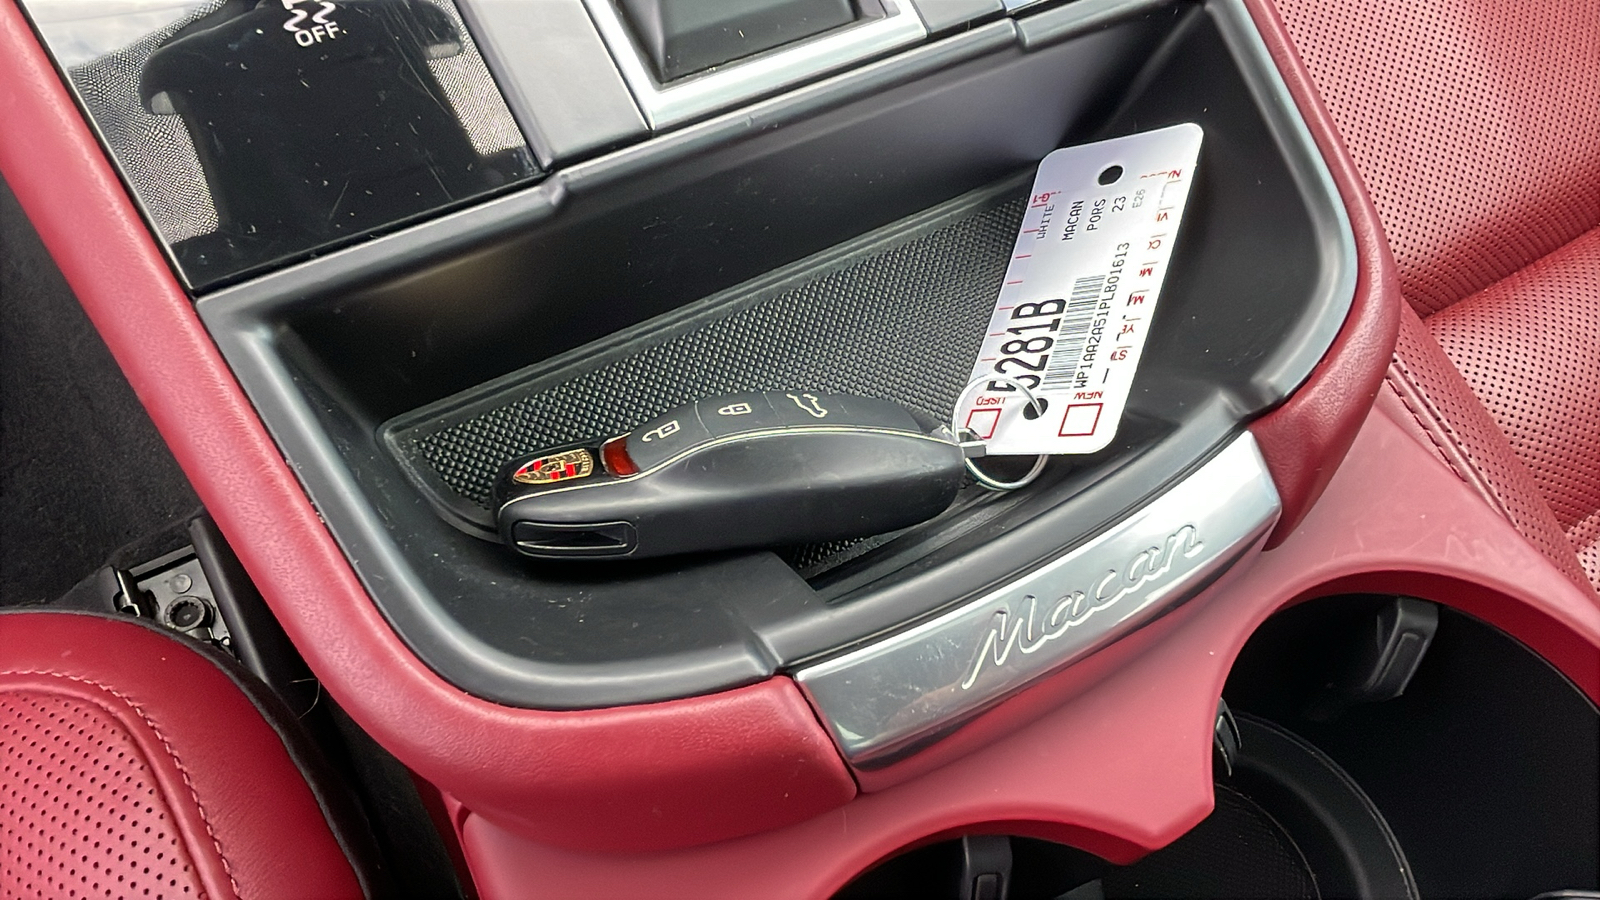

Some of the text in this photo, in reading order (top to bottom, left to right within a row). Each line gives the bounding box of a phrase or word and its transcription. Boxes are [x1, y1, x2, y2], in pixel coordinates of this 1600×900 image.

[294, 21, 340, 47] OFF
[1061, 200, 1085, 241] MACAN
[1086, 198, 1107, 231] PORS
[1111, 195, 1127, 213] 23
[1036, 204, 1055, 240] WHITE
[960, 523, 1205, 690] Macan
